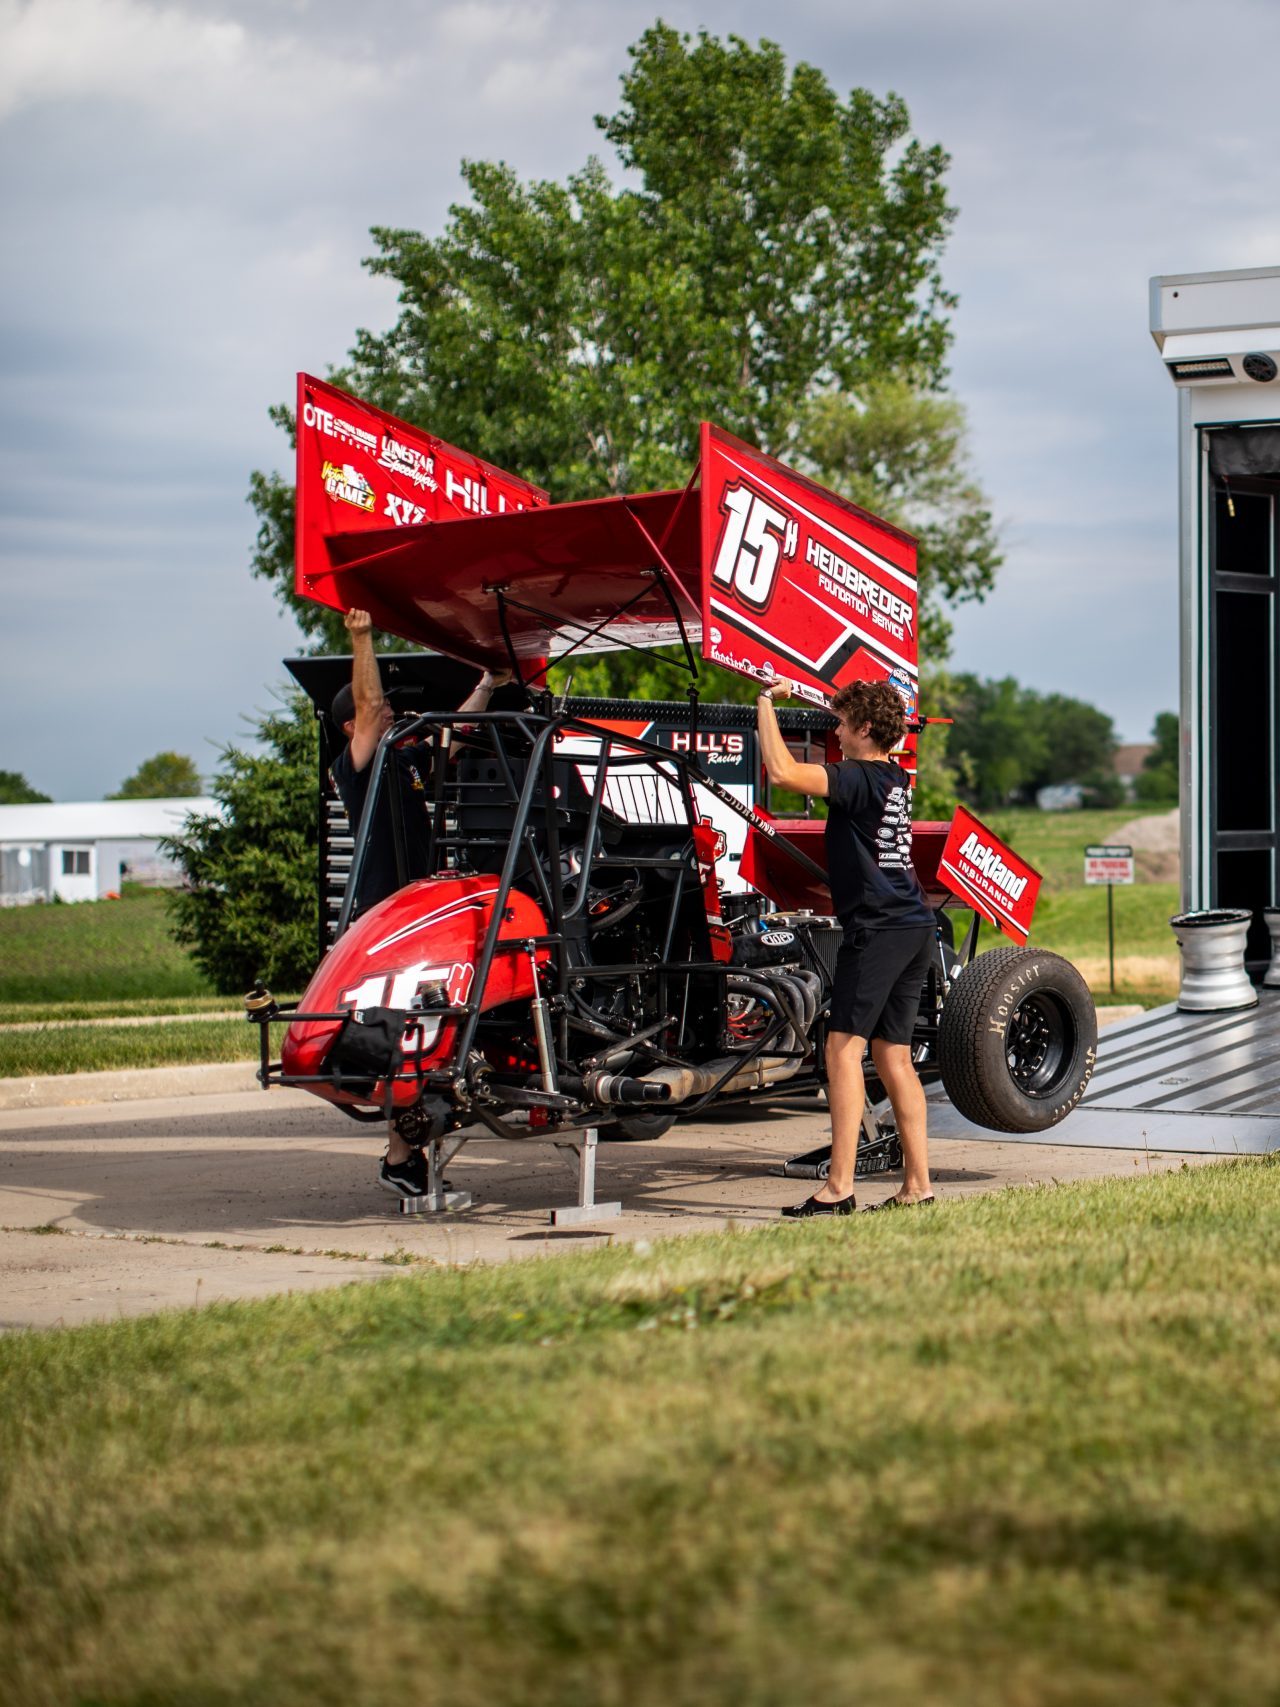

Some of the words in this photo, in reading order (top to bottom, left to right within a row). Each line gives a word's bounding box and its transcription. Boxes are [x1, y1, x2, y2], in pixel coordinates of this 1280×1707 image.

[303, 402, 332, 436] OTE
[377, 450, 439, 493] Speedway
[381, 435, 435, 475] LONESTAR
[805, 537, 914, 638] HEIDBREDER
[818, 574, 869, 618] FOUNDATION
[871, 609, 904, 641] SERVICE
[671, 731, 744, 752] HLL'S
[707, 752, 743, 766] Racing
[958, 831, 1028, 901] Ackland
[958, 858, 1015, 912] INSURANCE
